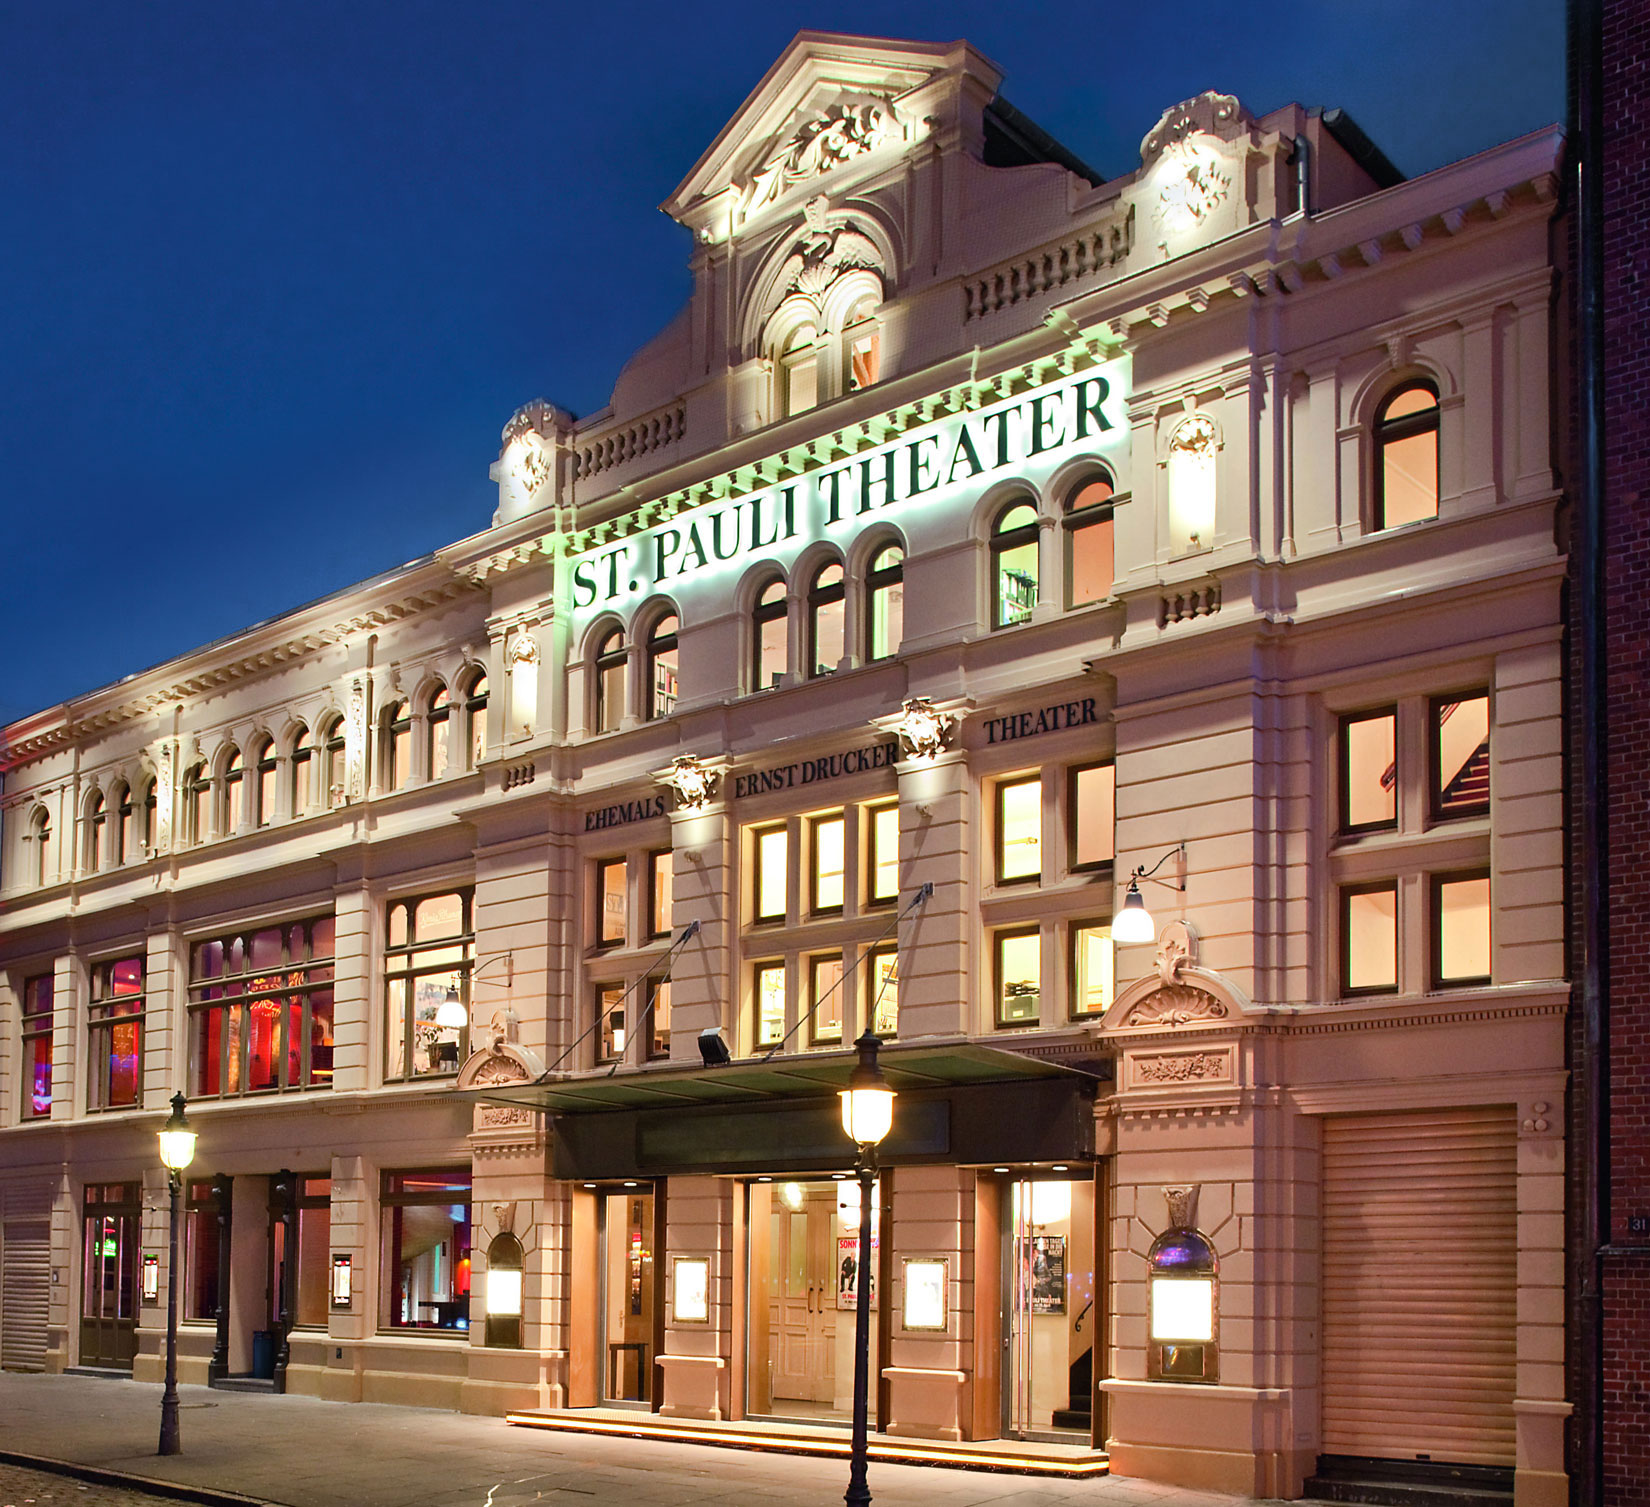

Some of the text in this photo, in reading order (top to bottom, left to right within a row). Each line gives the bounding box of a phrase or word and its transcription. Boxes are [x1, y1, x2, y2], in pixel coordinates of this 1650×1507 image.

[573, 376, 1115, 609] ST. PAULI THEATER
[584, 698, 1097, 831] EHEMALS ERNST DRUCKER THEATER
